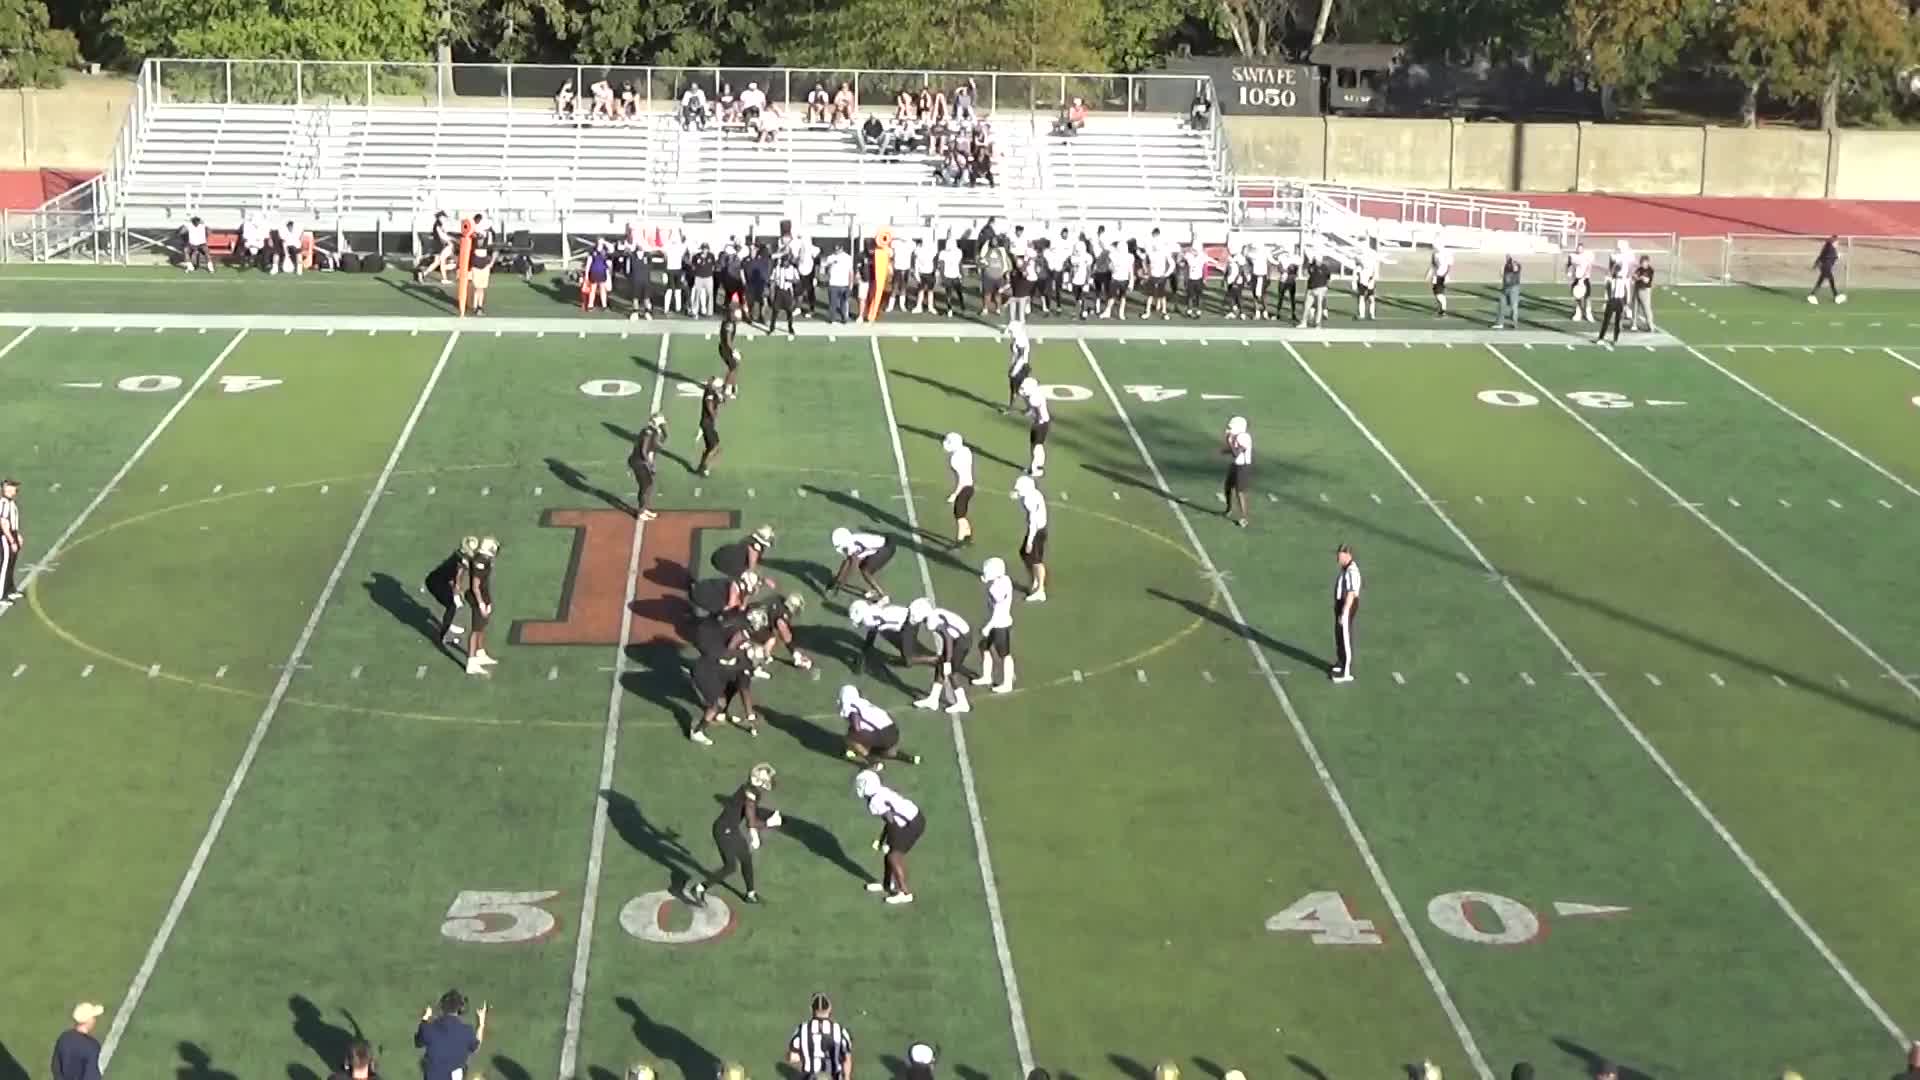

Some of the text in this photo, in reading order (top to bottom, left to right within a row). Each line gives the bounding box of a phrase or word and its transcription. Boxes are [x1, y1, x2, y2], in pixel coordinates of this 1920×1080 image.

[1231, 66, 1297, 85] SANTA FE
[1239, 86, 1297, 107] 1050
